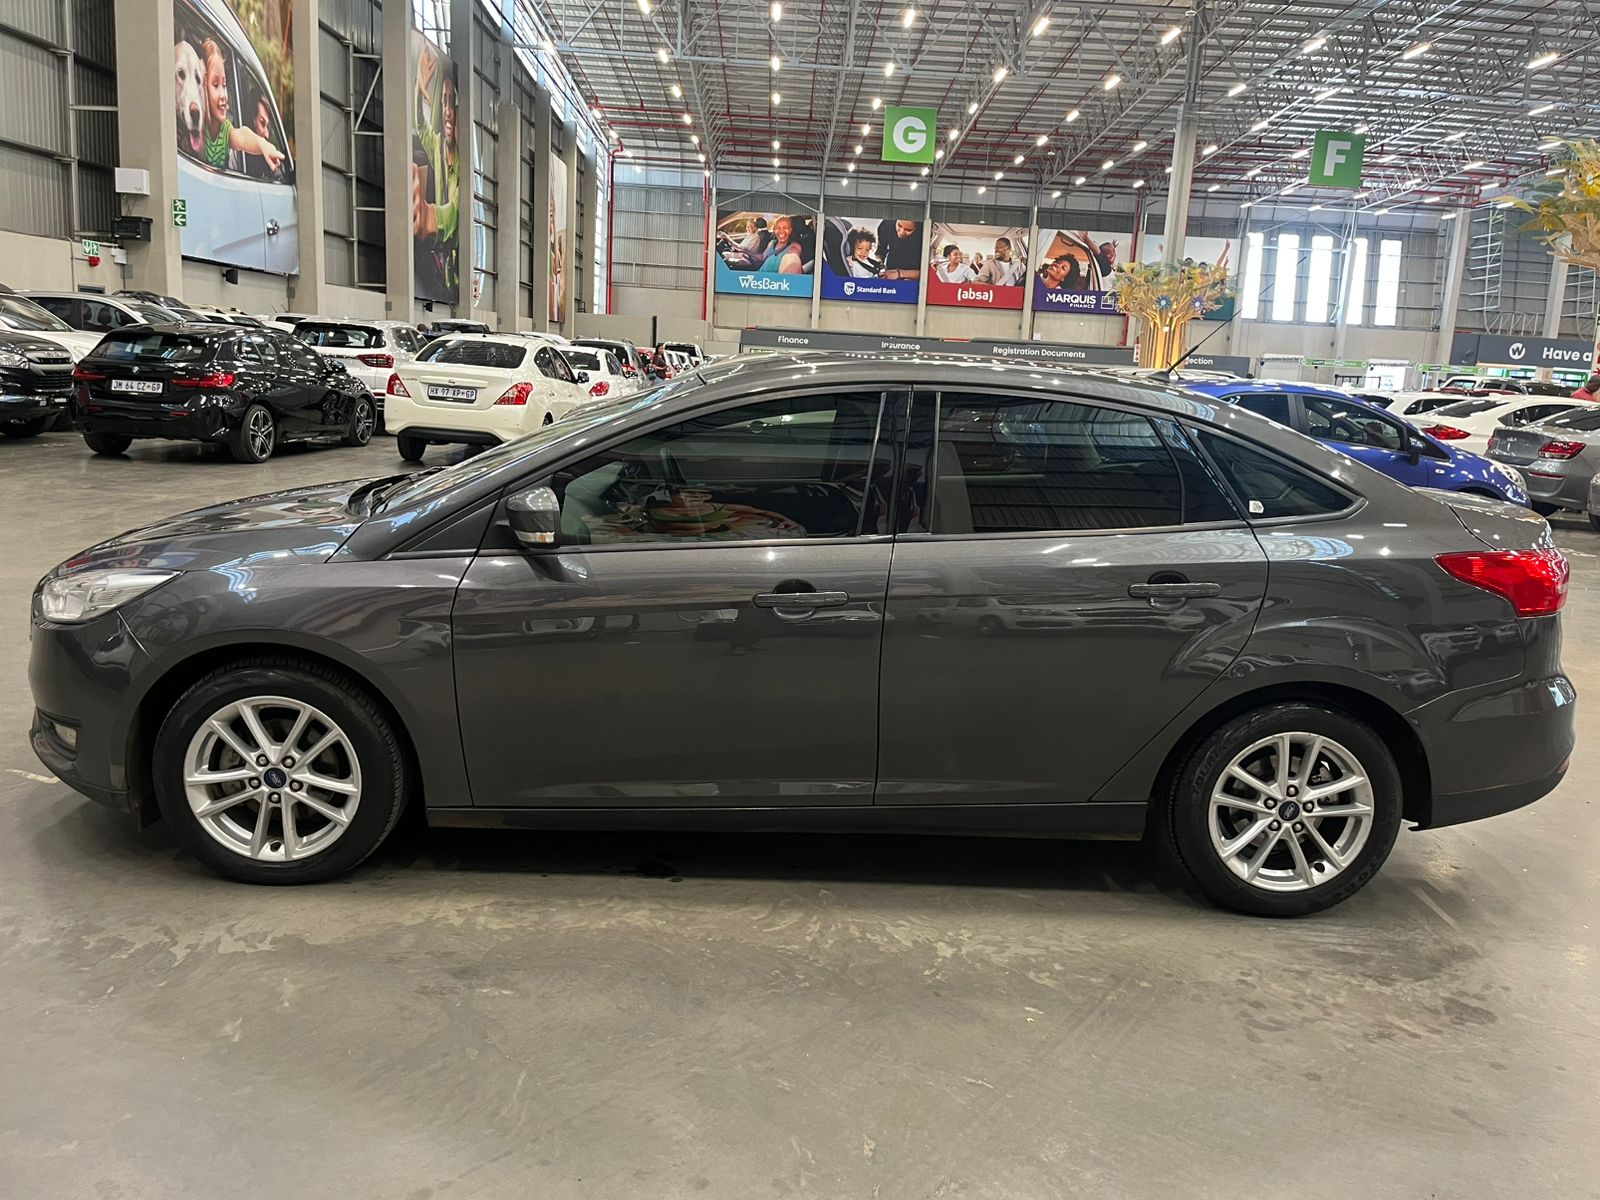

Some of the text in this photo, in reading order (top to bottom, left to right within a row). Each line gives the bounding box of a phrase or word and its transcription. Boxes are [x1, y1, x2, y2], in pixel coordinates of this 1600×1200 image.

[893, 116, 927, 154] G
[1323, 140, 1352, 177] F
[738, 274, 790, 291] WesBank
[856, 286, 882, 294] Standard
[1046, 293, 1097, 305] MARQUIS
[777, 335, 809, 345] Finance
[881, 341, 921, 350] Insurance
[992, 346, 1086, 358] Registration Documents
[1542, 346, 1581, 361] Have
